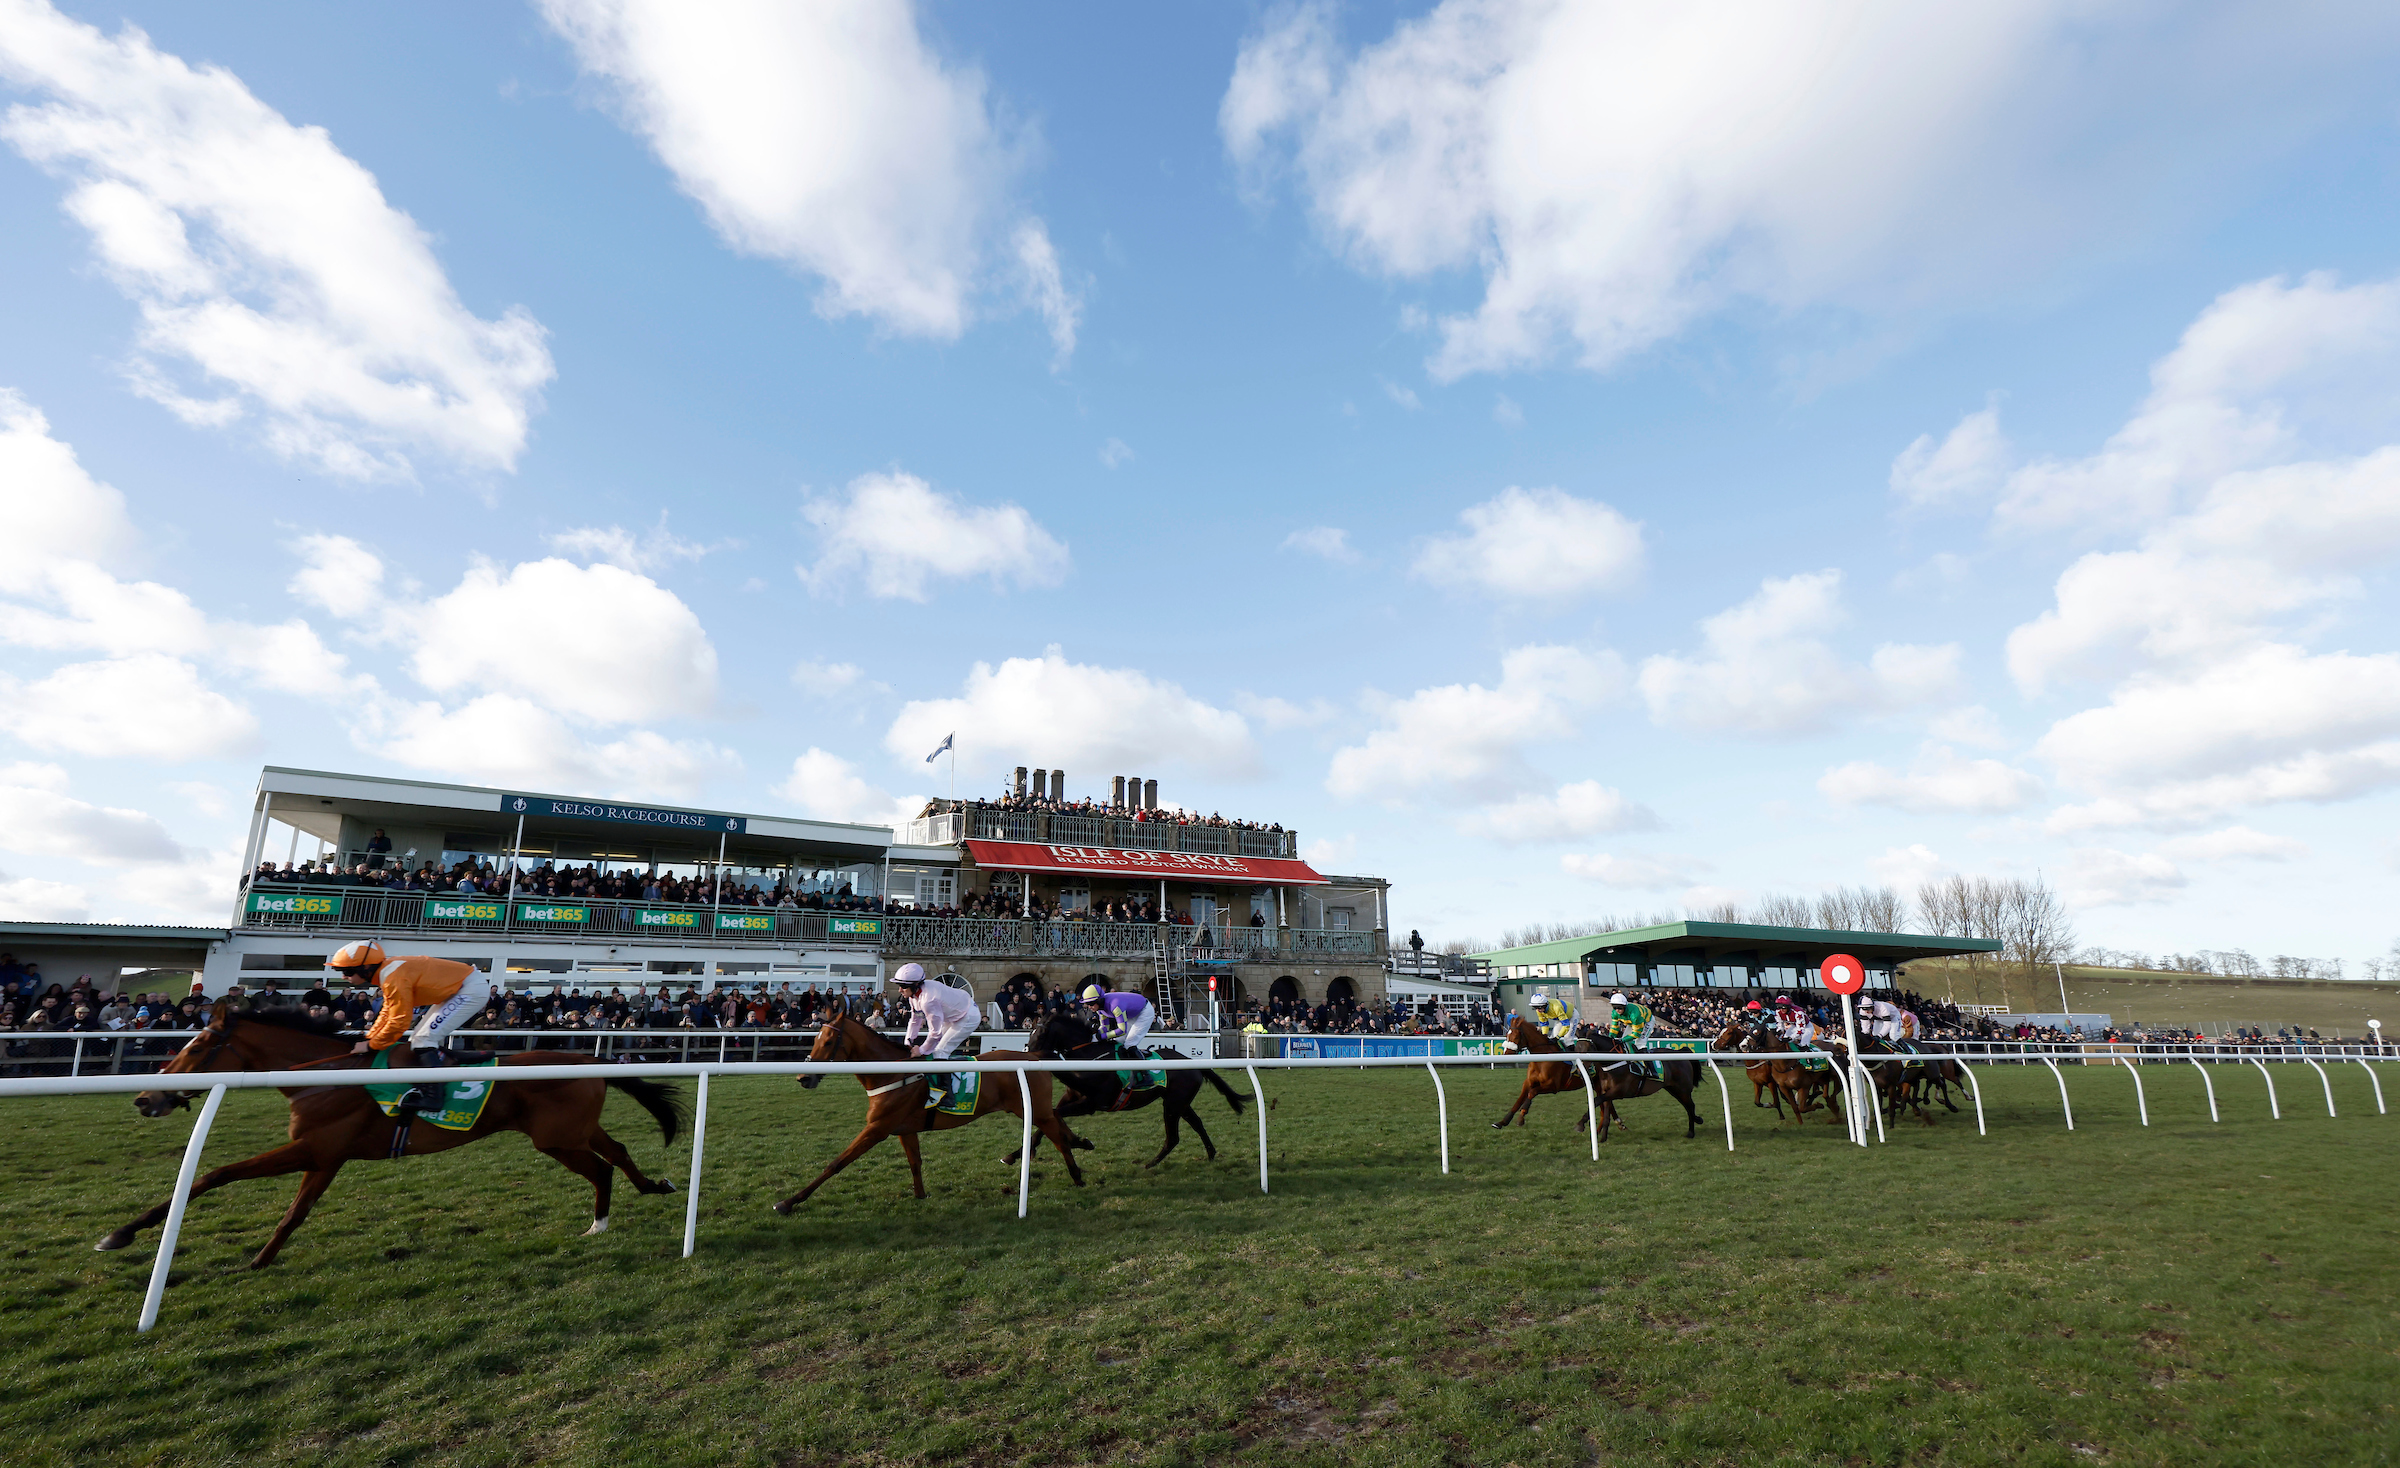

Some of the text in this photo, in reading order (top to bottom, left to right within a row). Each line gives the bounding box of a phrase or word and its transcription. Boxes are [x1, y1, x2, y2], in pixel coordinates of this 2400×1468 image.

[551, 803, 706, 827] KELSO RACECOURSE
[1048, 846, 1245, 867] ISLE OF SKYE
[1056, 857, 1250, 873] BLENDED SCOTCH WHISKY
[256, 896, 332, 912] bet365
[433, 903, 497, 919] bet365
[525, 906, 583, 921] bet365
[641, 911, 694, 926] bet365
[720, 916, 769, 929] bet365
[834, 921, 877, 933] bet365
[1325, 1045, 1374, 1058] WINNER
[1378, 1045, 1394, 1058] BY
[1397, 1045, 1405, 1057] A
[1457, 1041, 1504, 1056] bet36
